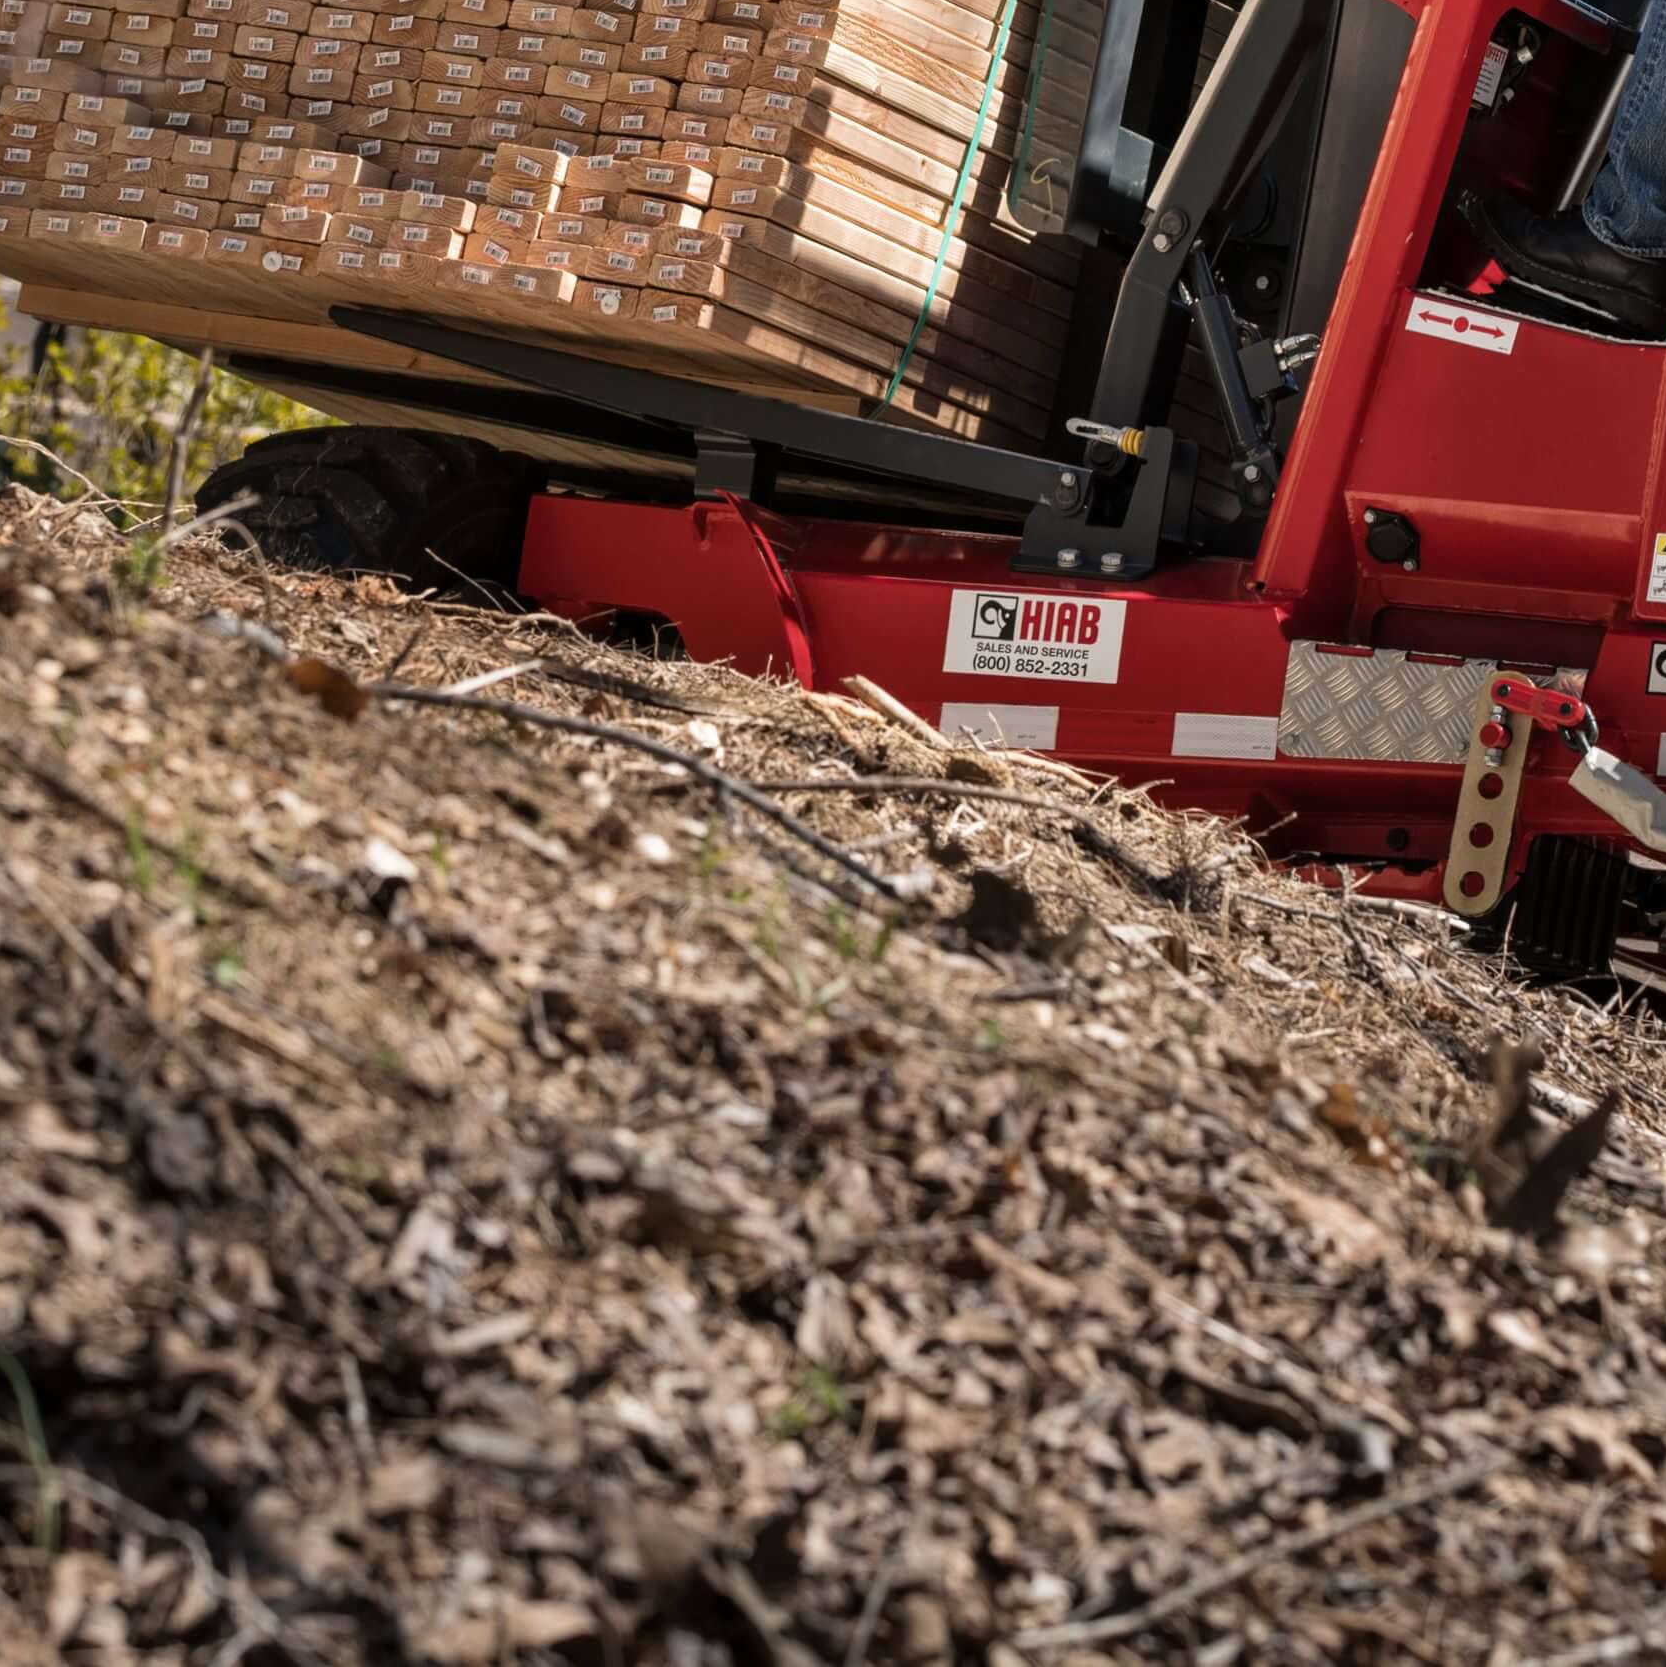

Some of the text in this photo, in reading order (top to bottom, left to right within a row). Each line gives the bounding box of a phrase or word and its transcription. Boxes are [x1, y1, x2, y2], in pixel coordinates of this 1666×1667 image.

[1019, 600, 1101, 645] HIAB
[976, 642, 1089, 659] SALES AND SERVICE
[973, 653, 1088, 677] (800) 852-2331
